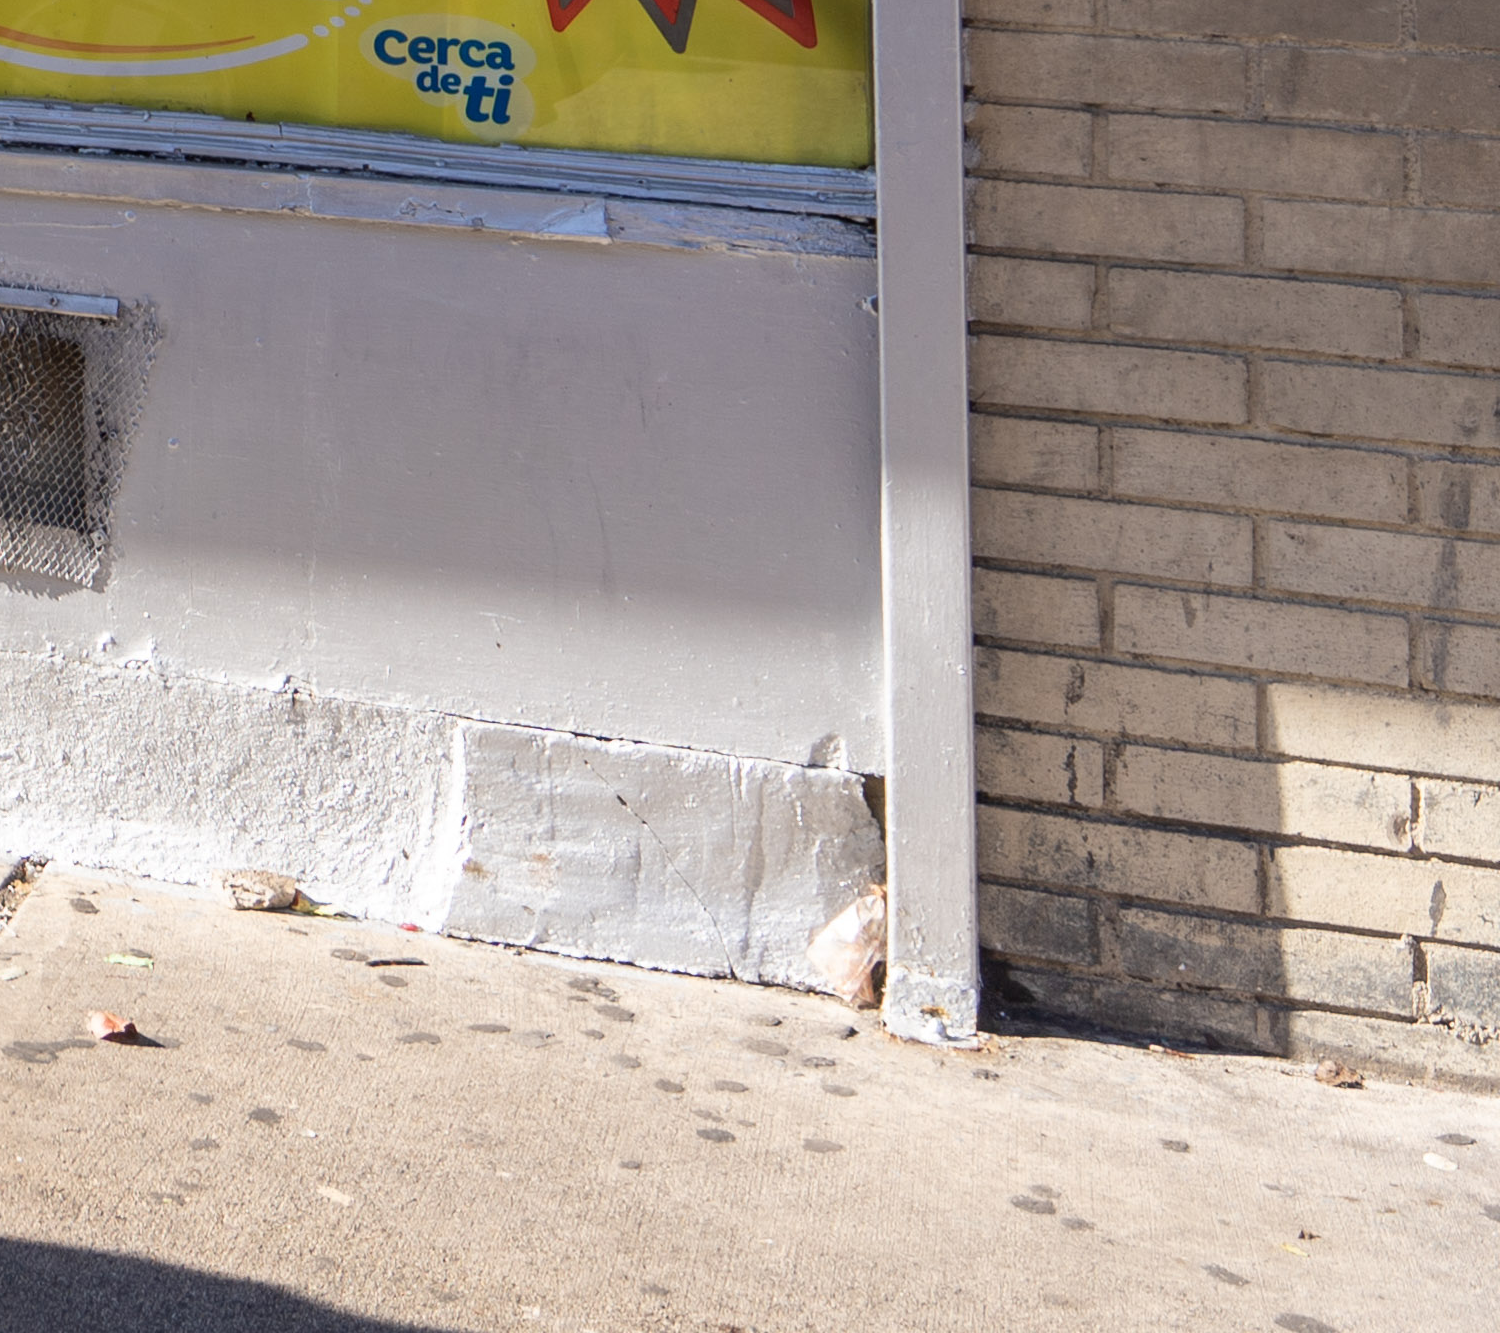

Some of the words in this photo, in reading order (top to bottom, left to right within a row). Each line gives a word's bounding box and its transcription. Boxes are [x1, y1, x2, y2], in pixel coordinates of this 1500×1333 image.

[373, 29, 516, 72] Cerca
[416, 65, 461, 94] de
[464, 74, 515, 125] ti
